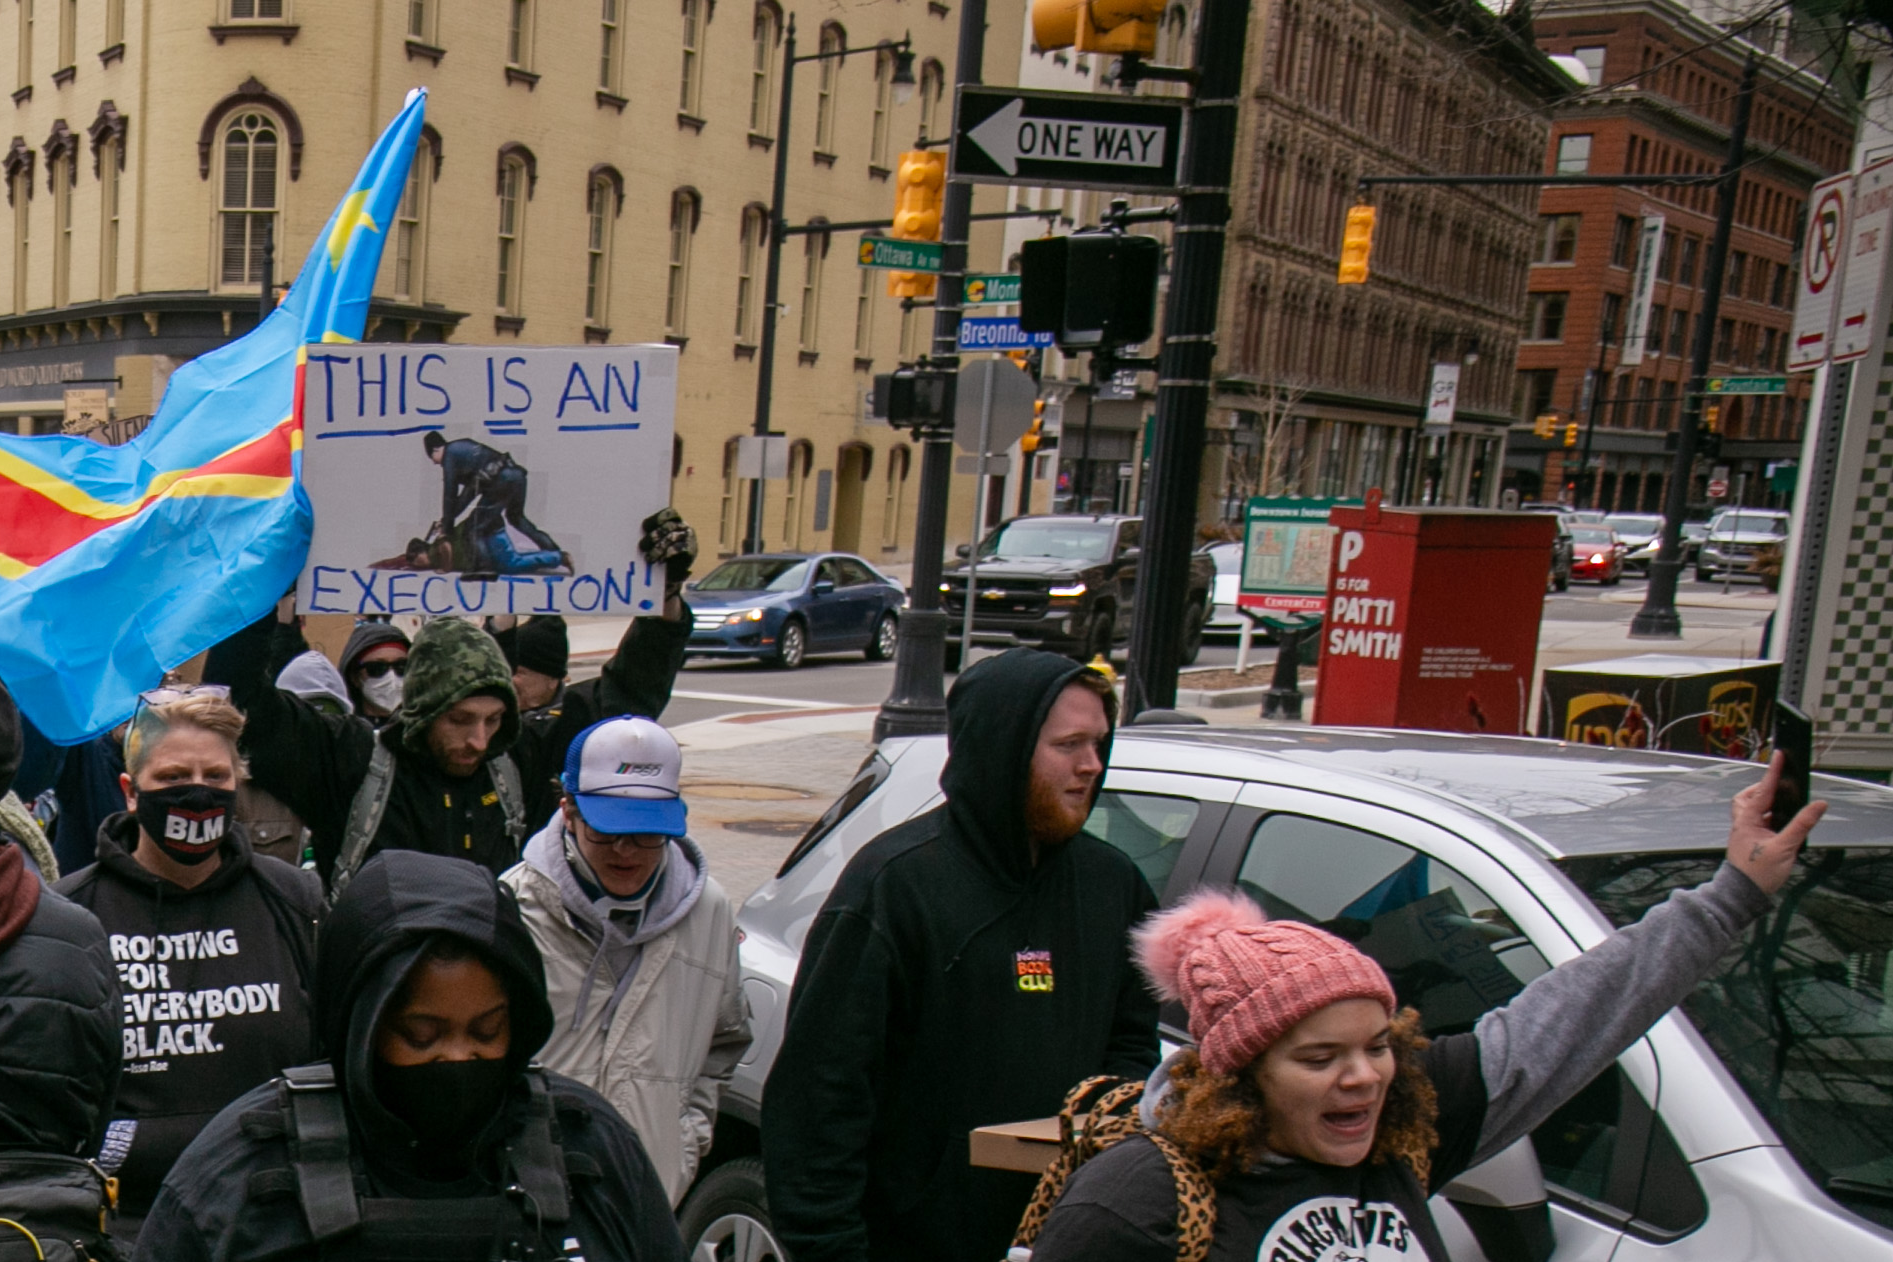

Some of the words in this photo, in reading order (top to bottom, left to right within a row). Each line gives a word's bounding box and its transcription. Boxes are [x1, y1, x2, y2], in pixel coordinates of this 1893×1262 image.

[1018, 122, 1083, 158] ONE
[1093, 126, 1157, 162] WAY
[875, 242, 913, 265] Ottawa
[308, 353, 452, 423] THIS
[486, 356, 532, 414] IS
[556, 360, 640, 418] AN
[1338, 531, 1364, 573] P
[309, 561, 654, 614] EXECUTION!
[1336, 578, 1346, 591] IS
[1348, 578, 1370, 592] FOR
[1332, 596, 1395, 627] PATTI
[1329, 629, 1402, 660] SMITH
[164, 814, 225, 845] BLM
[109, 929, 240, 962] ROOTING
[116, 963, 171, 990] FOR
[123, 983, 280, 1024] EVERYBODY
[122, 1022, 225, 1060] BLACK.
